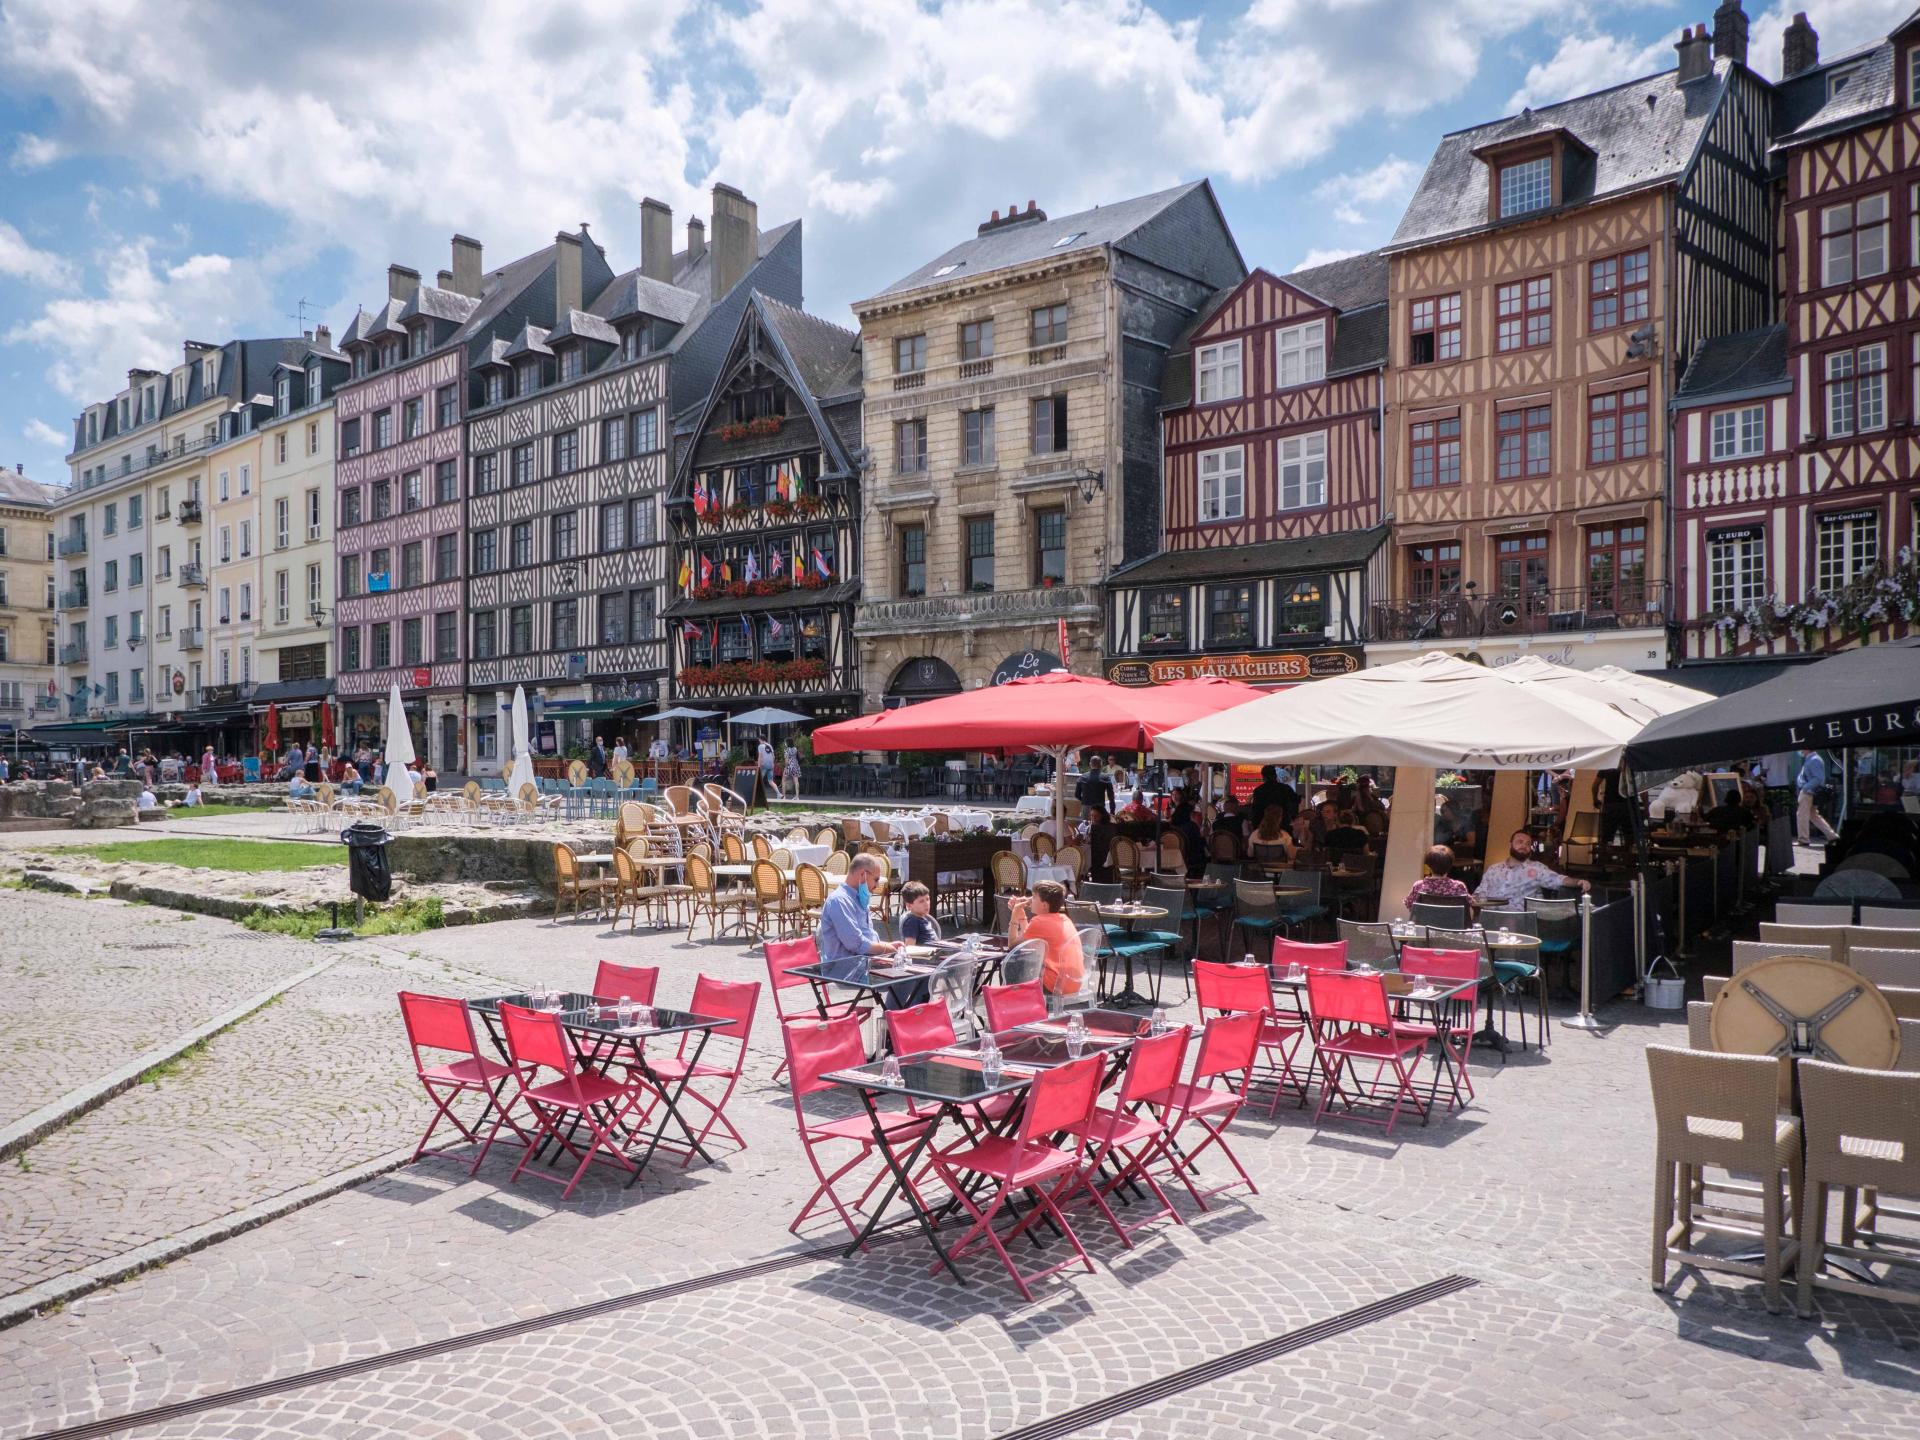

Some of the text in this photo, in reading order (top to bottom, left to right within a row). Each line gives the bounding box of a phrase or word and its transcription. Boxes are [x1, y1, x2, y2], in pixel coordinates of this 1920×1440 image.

[1718, 530, 1751, 540] L'EURO
[1018, 652, 1040, 669] Le
[1647, 650, 1657, 659] 39
[1158, 660, 1301, 680] LES MARAICHERS
[1453, 746, 1576, 766] Marcel
